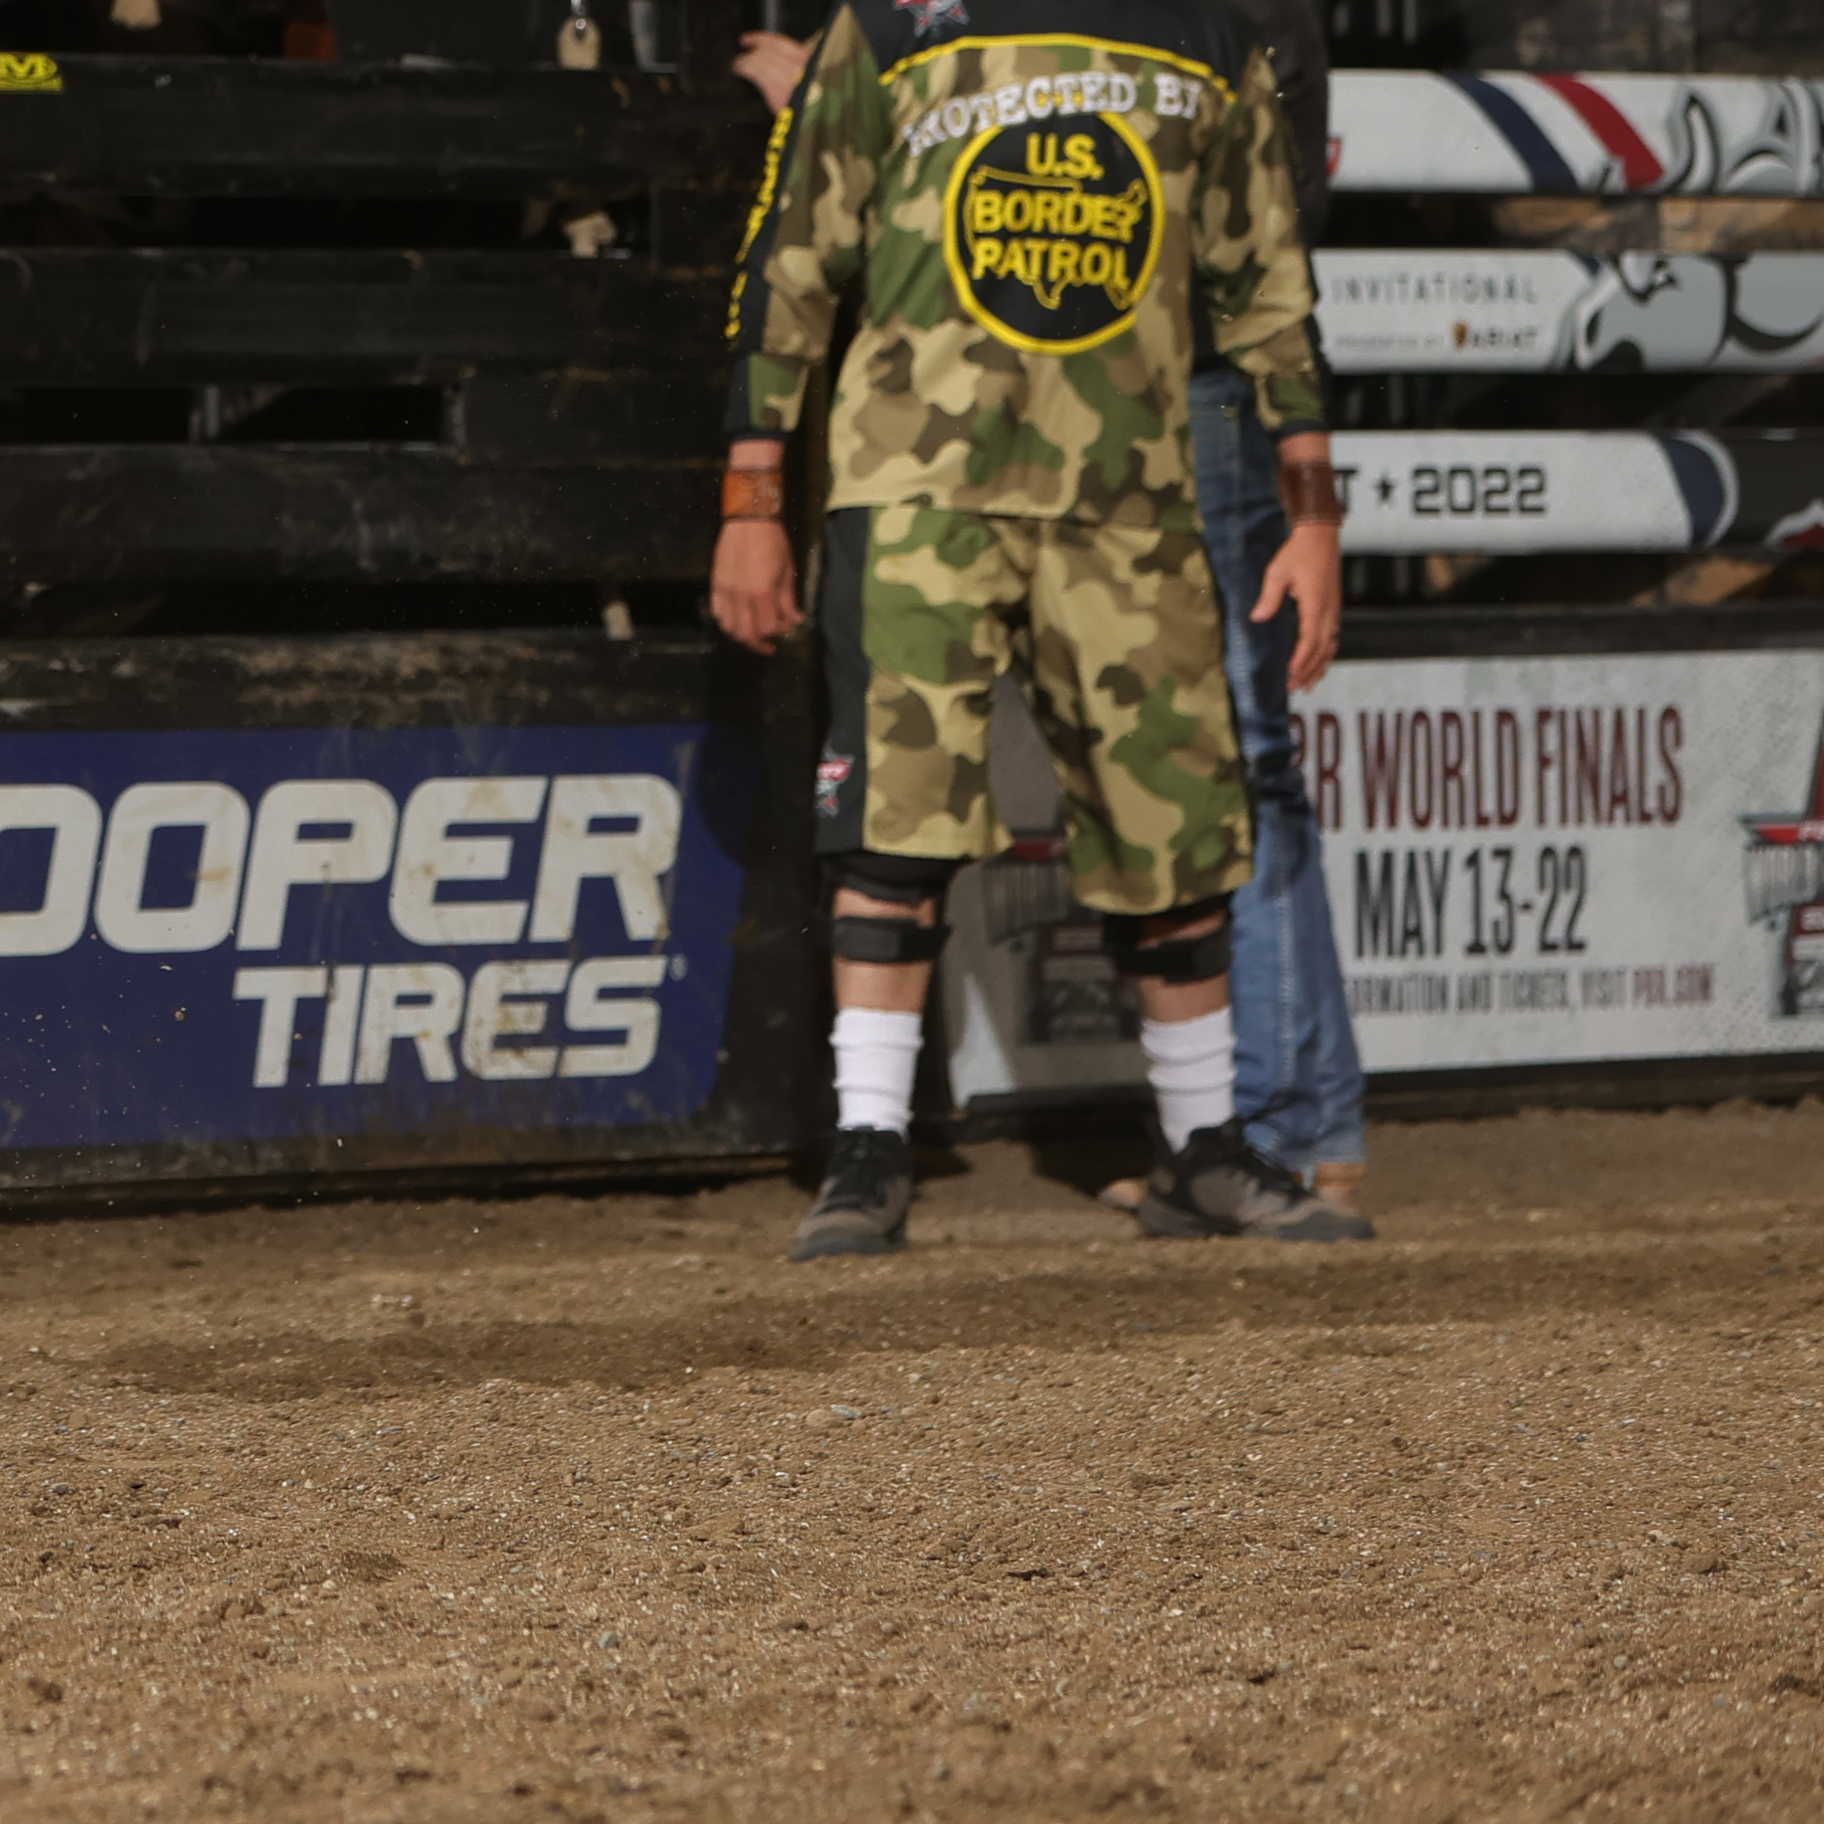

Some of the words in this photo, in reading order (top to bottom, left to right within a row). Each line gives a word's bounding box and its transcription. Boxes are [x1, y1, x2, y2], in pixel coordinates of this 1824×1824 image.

[1026, 132, 1104, 180] U.S.
[974, 189, 1143, 243] BORDER
[972, 236, 1131, 290] PATROL
[1412, 467, 1548, 515] 2022
[1359, 707, 1522, 831] WORLD
[1536, 705, 1683, 826] FINALS
[1356, 846, 1451, 958] MAY
[1465, 844, 1588, 956] 13-22
[232, 955, 666, 1087] TIRES
